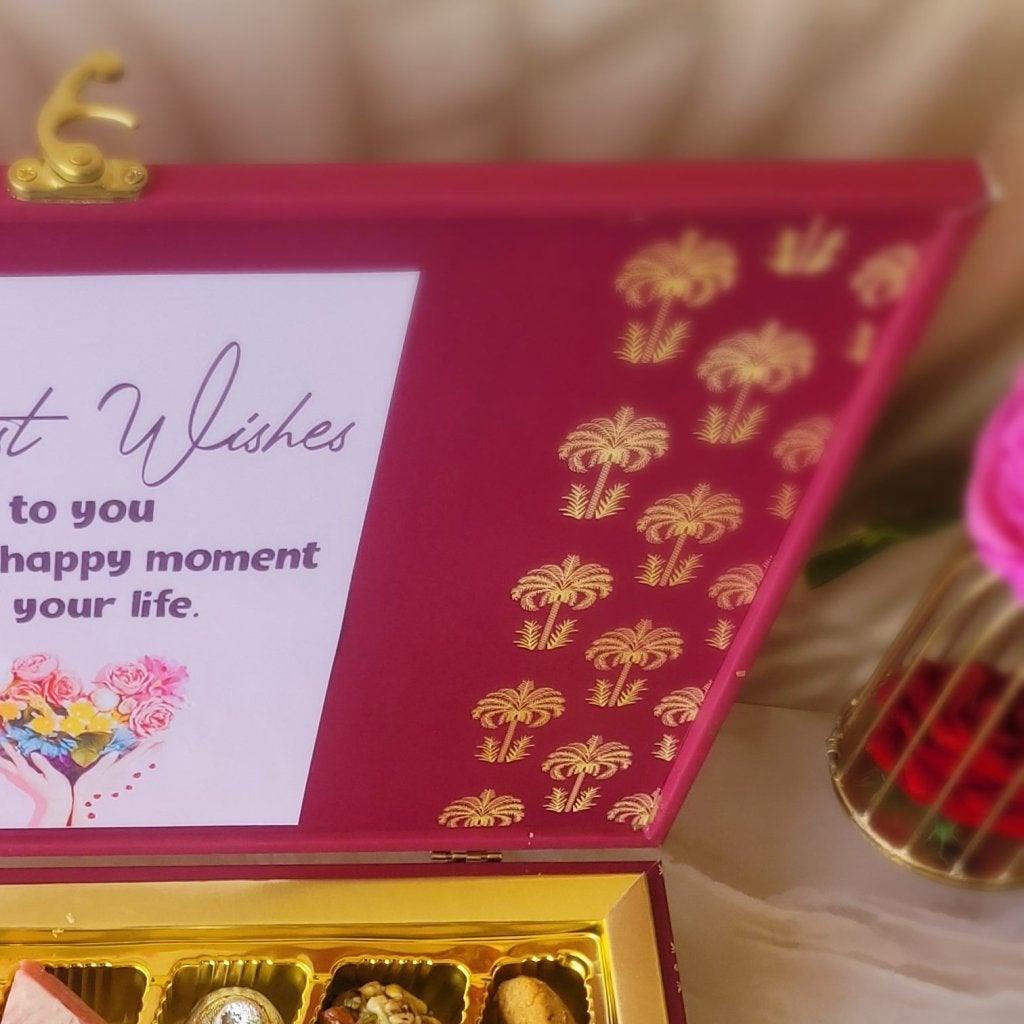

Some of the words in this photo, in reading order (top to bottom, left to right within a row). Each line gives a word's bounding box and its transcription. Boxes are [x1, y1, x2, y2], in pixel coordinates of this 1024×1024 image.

[97, 341, 356, 487] Wishes
[8, 495, 57, 525] to
[70, 499, 155, 529] you
[0, 545, 132, 582] happy
[145, 541, 322, 573] moment
[13, 597, 117, 624] your
[131, 588, 200, 620] life.
